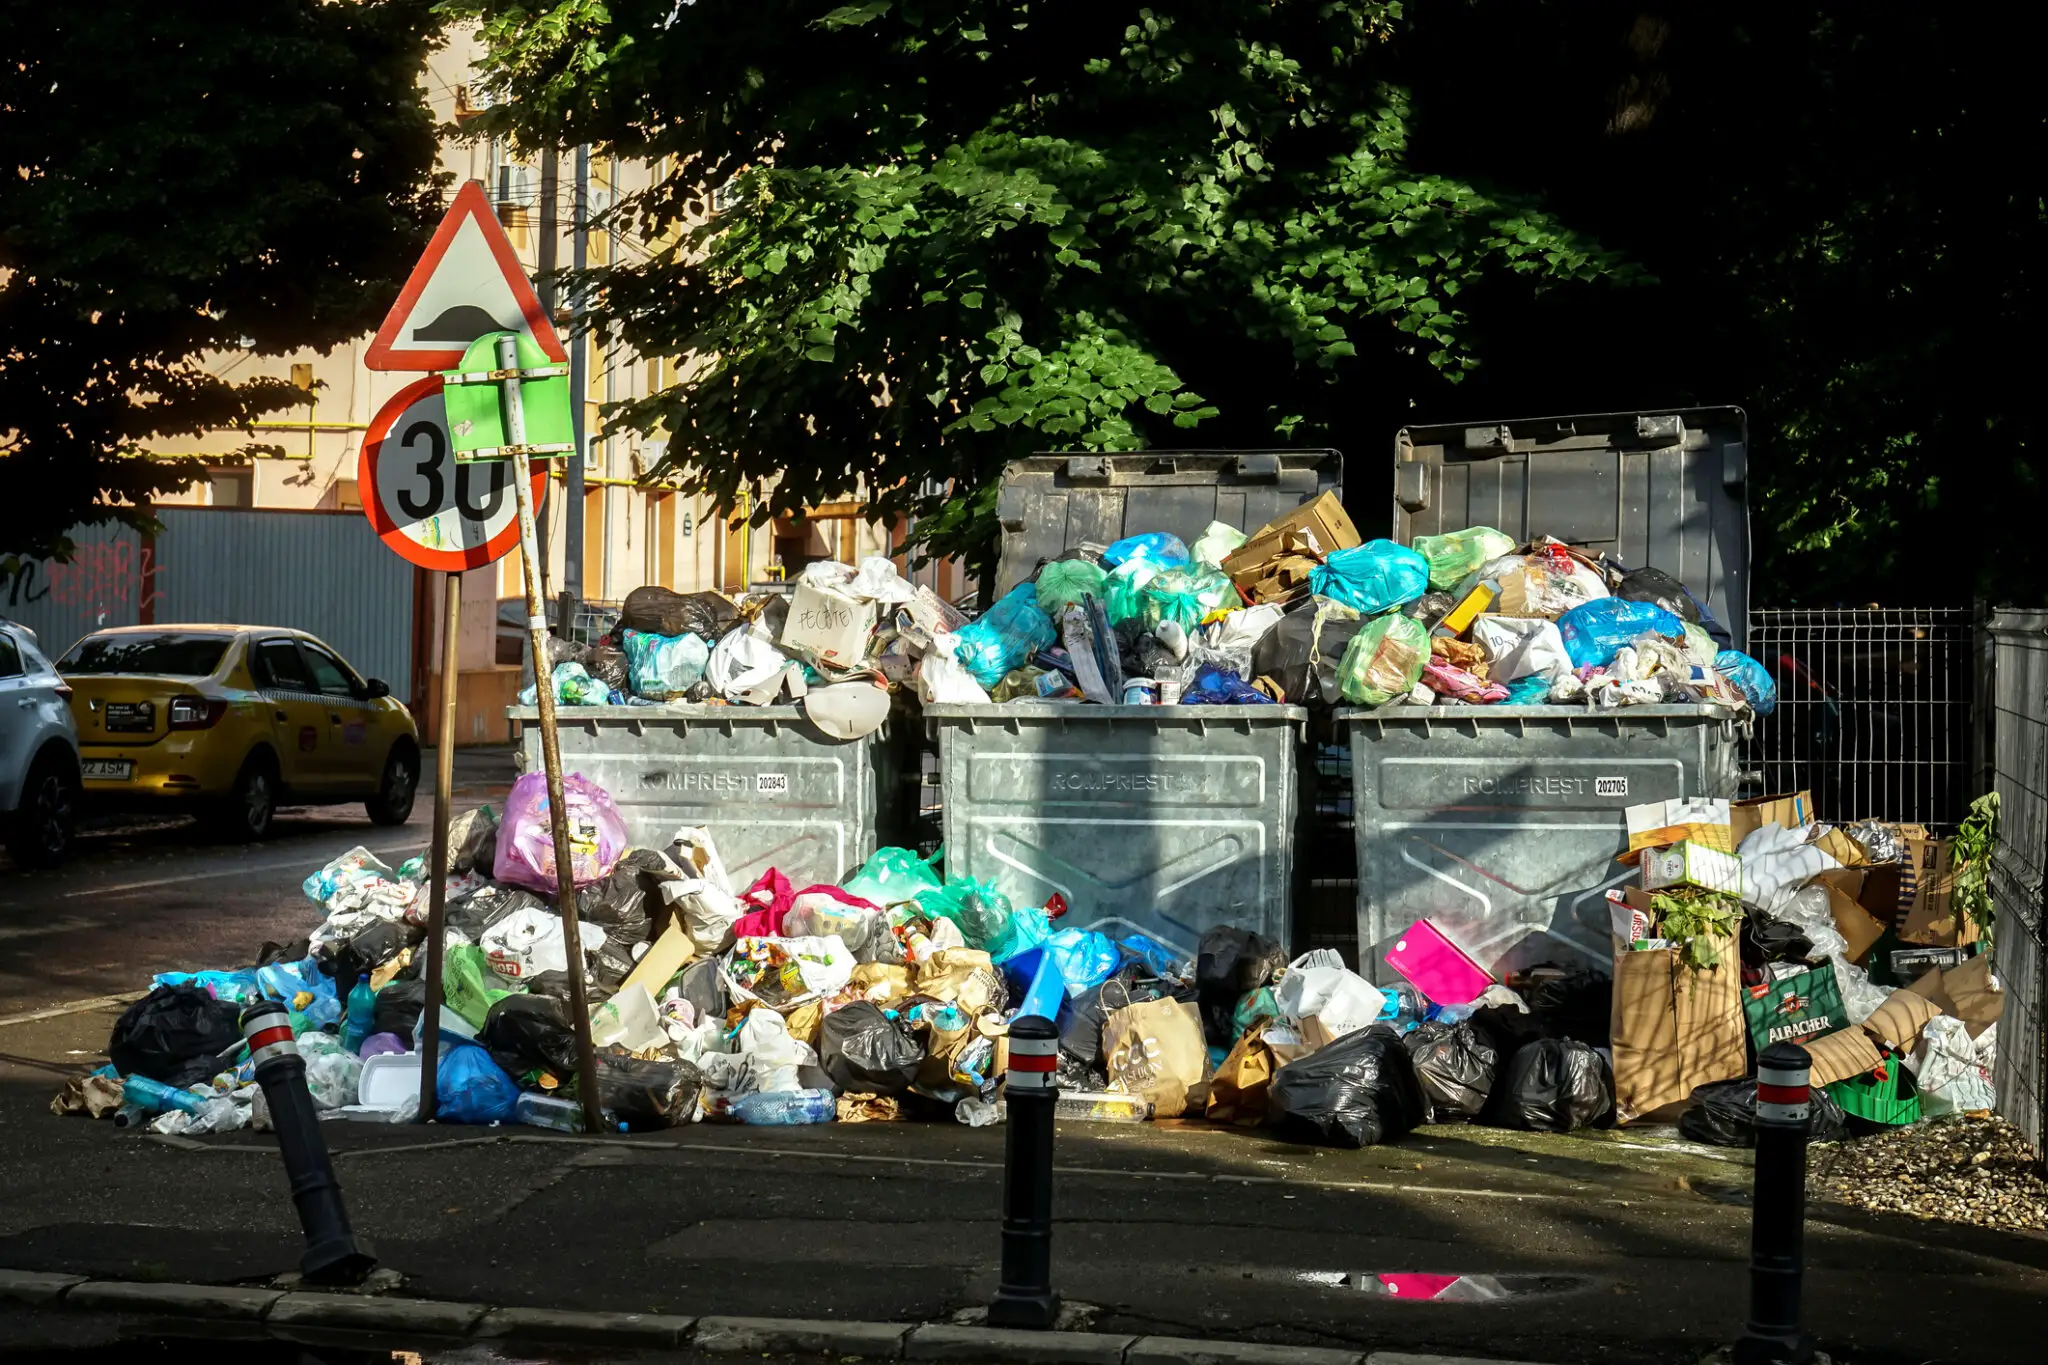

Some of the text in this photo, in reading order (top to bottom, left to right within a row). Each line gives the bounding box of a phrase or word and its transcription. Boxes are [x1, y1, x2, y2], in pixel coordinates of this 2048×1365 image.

[397, 421, 505, 522] 30
[100, 763, 124, 774] ASM
[636, 772, 754, 791] ROMPREST
[759, 777, 786, 789] 202843
[1052, 772, 1174, 791] ROMPREST
[1463, 776, 1589, 795] ROMPREST
[1597, 780, 1626, 793] 202705
[1769, 1016, 1833, 1043] ALBACHER
[1113, 1037, 1161, 1071] CCC
